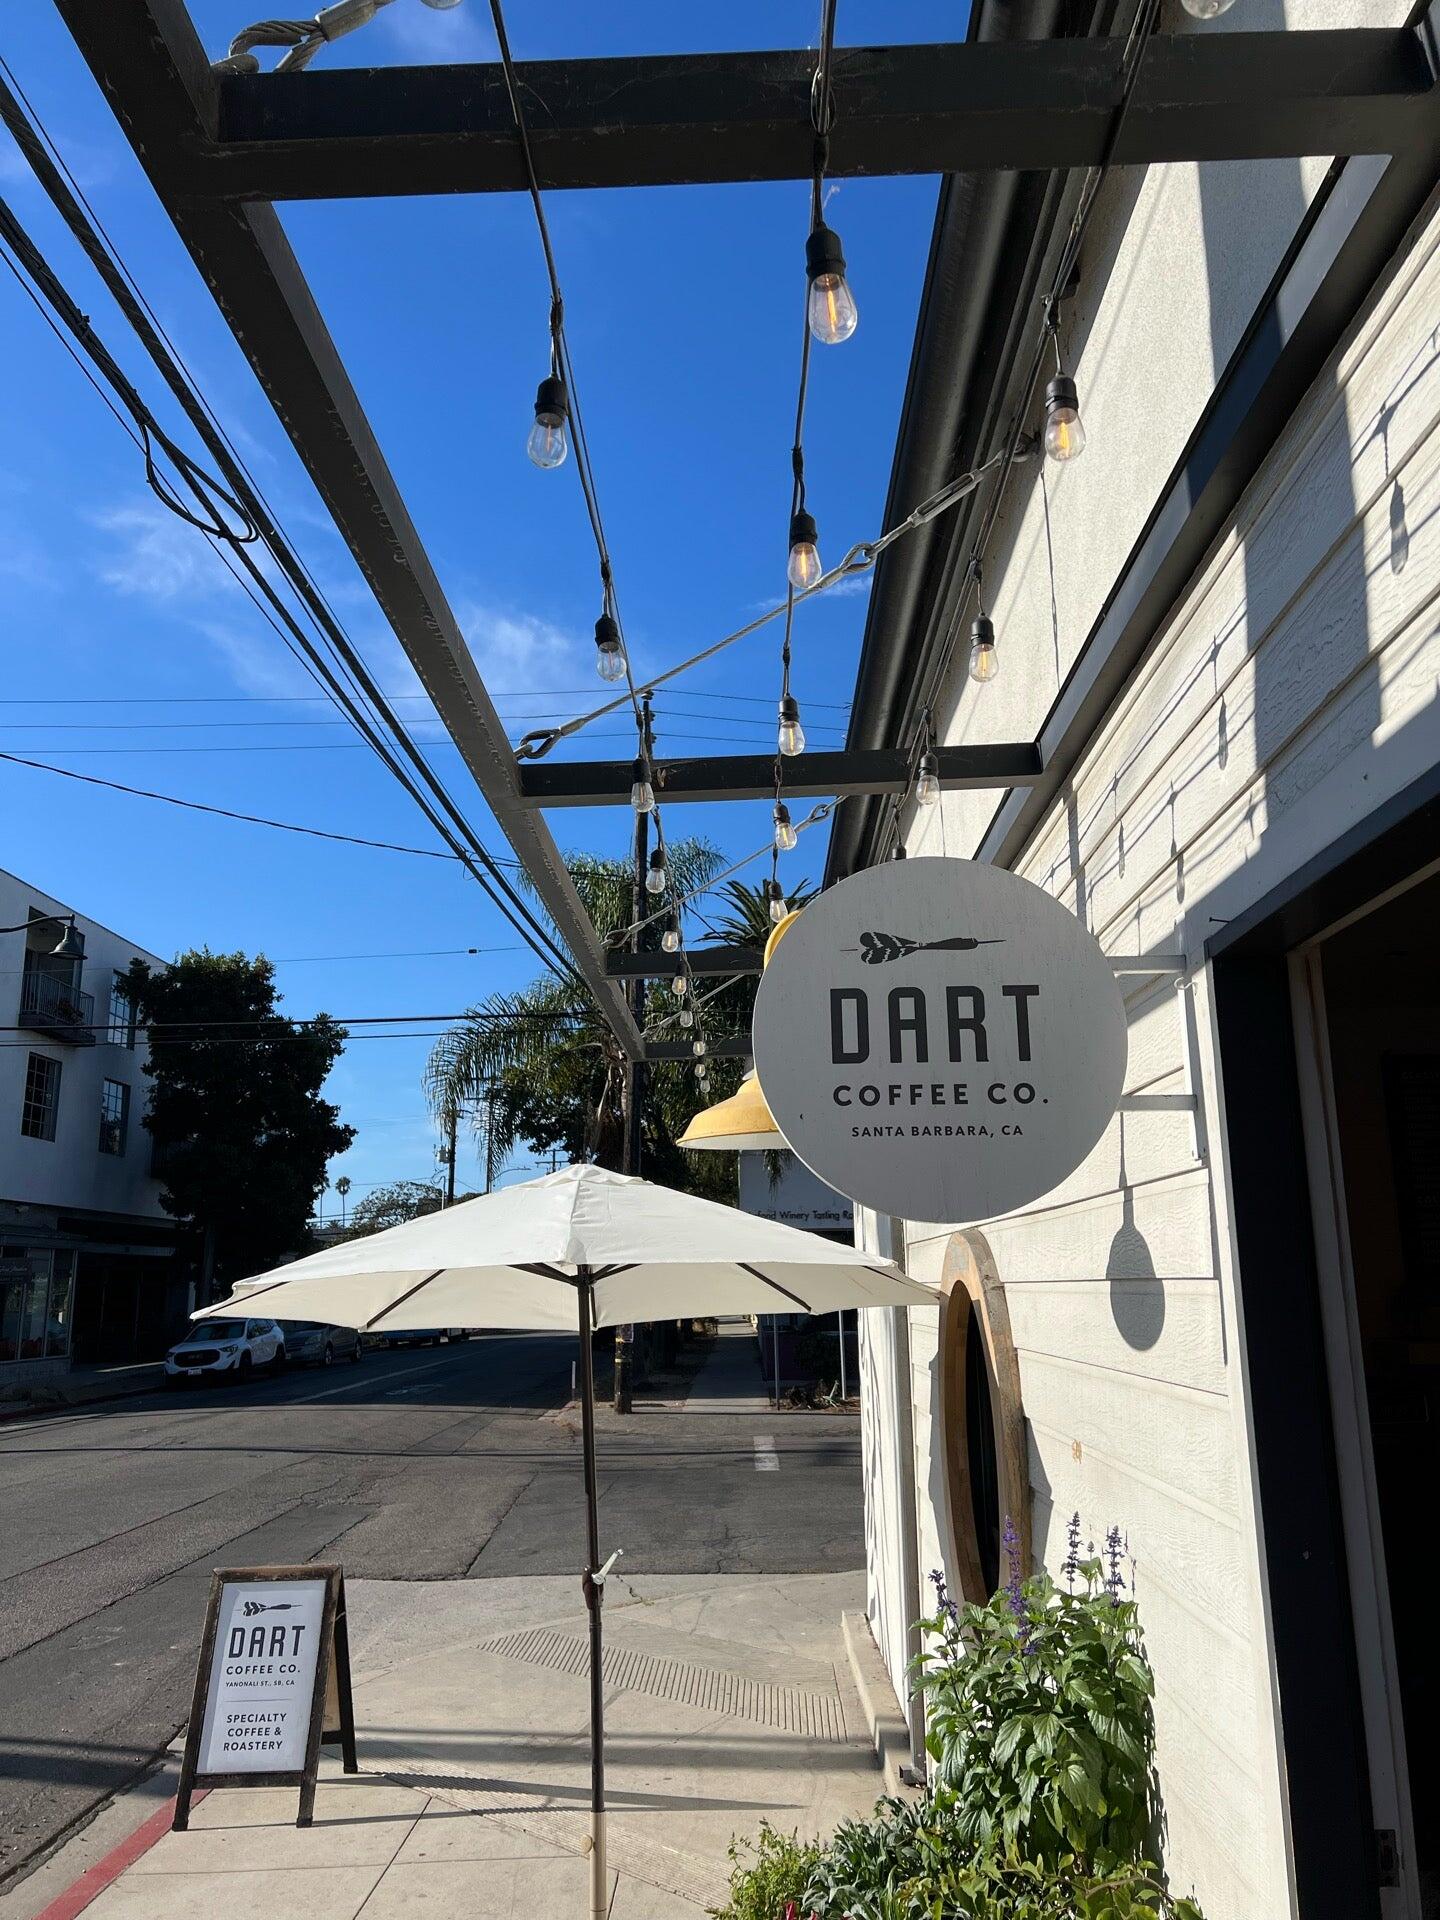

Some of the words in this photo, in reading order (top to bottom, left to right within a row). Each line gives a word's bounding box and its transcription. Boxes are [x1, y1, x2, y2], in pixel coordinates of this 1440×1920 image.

[830, 985, 1040, 1064] DART
[833, 1083, 969, 1106] COFFEE
[987, 1082, 1049, 1105] CO.
[852, 1126, 905, 1137] SANTA
[911, 1125, 994, 1138] BARBARA,
[1001, 1125, 1023, 1136] CA
[779, 1210, 809, 1221] Winery
[812, 1210, 840, 1221] Tasting
[228, 1625, 306, 1658] DART
[226, 1665, 273, 1675] COFFEE
[279, 1664, 300, 1673] CO.
[226, 1713, 287, 1723] SPECIALTY
[227, 1727, 271, 1737] COFFEE
[274, 1726, 282, 1736] &
[223, 1741, 283, 1751] ROASTERY
